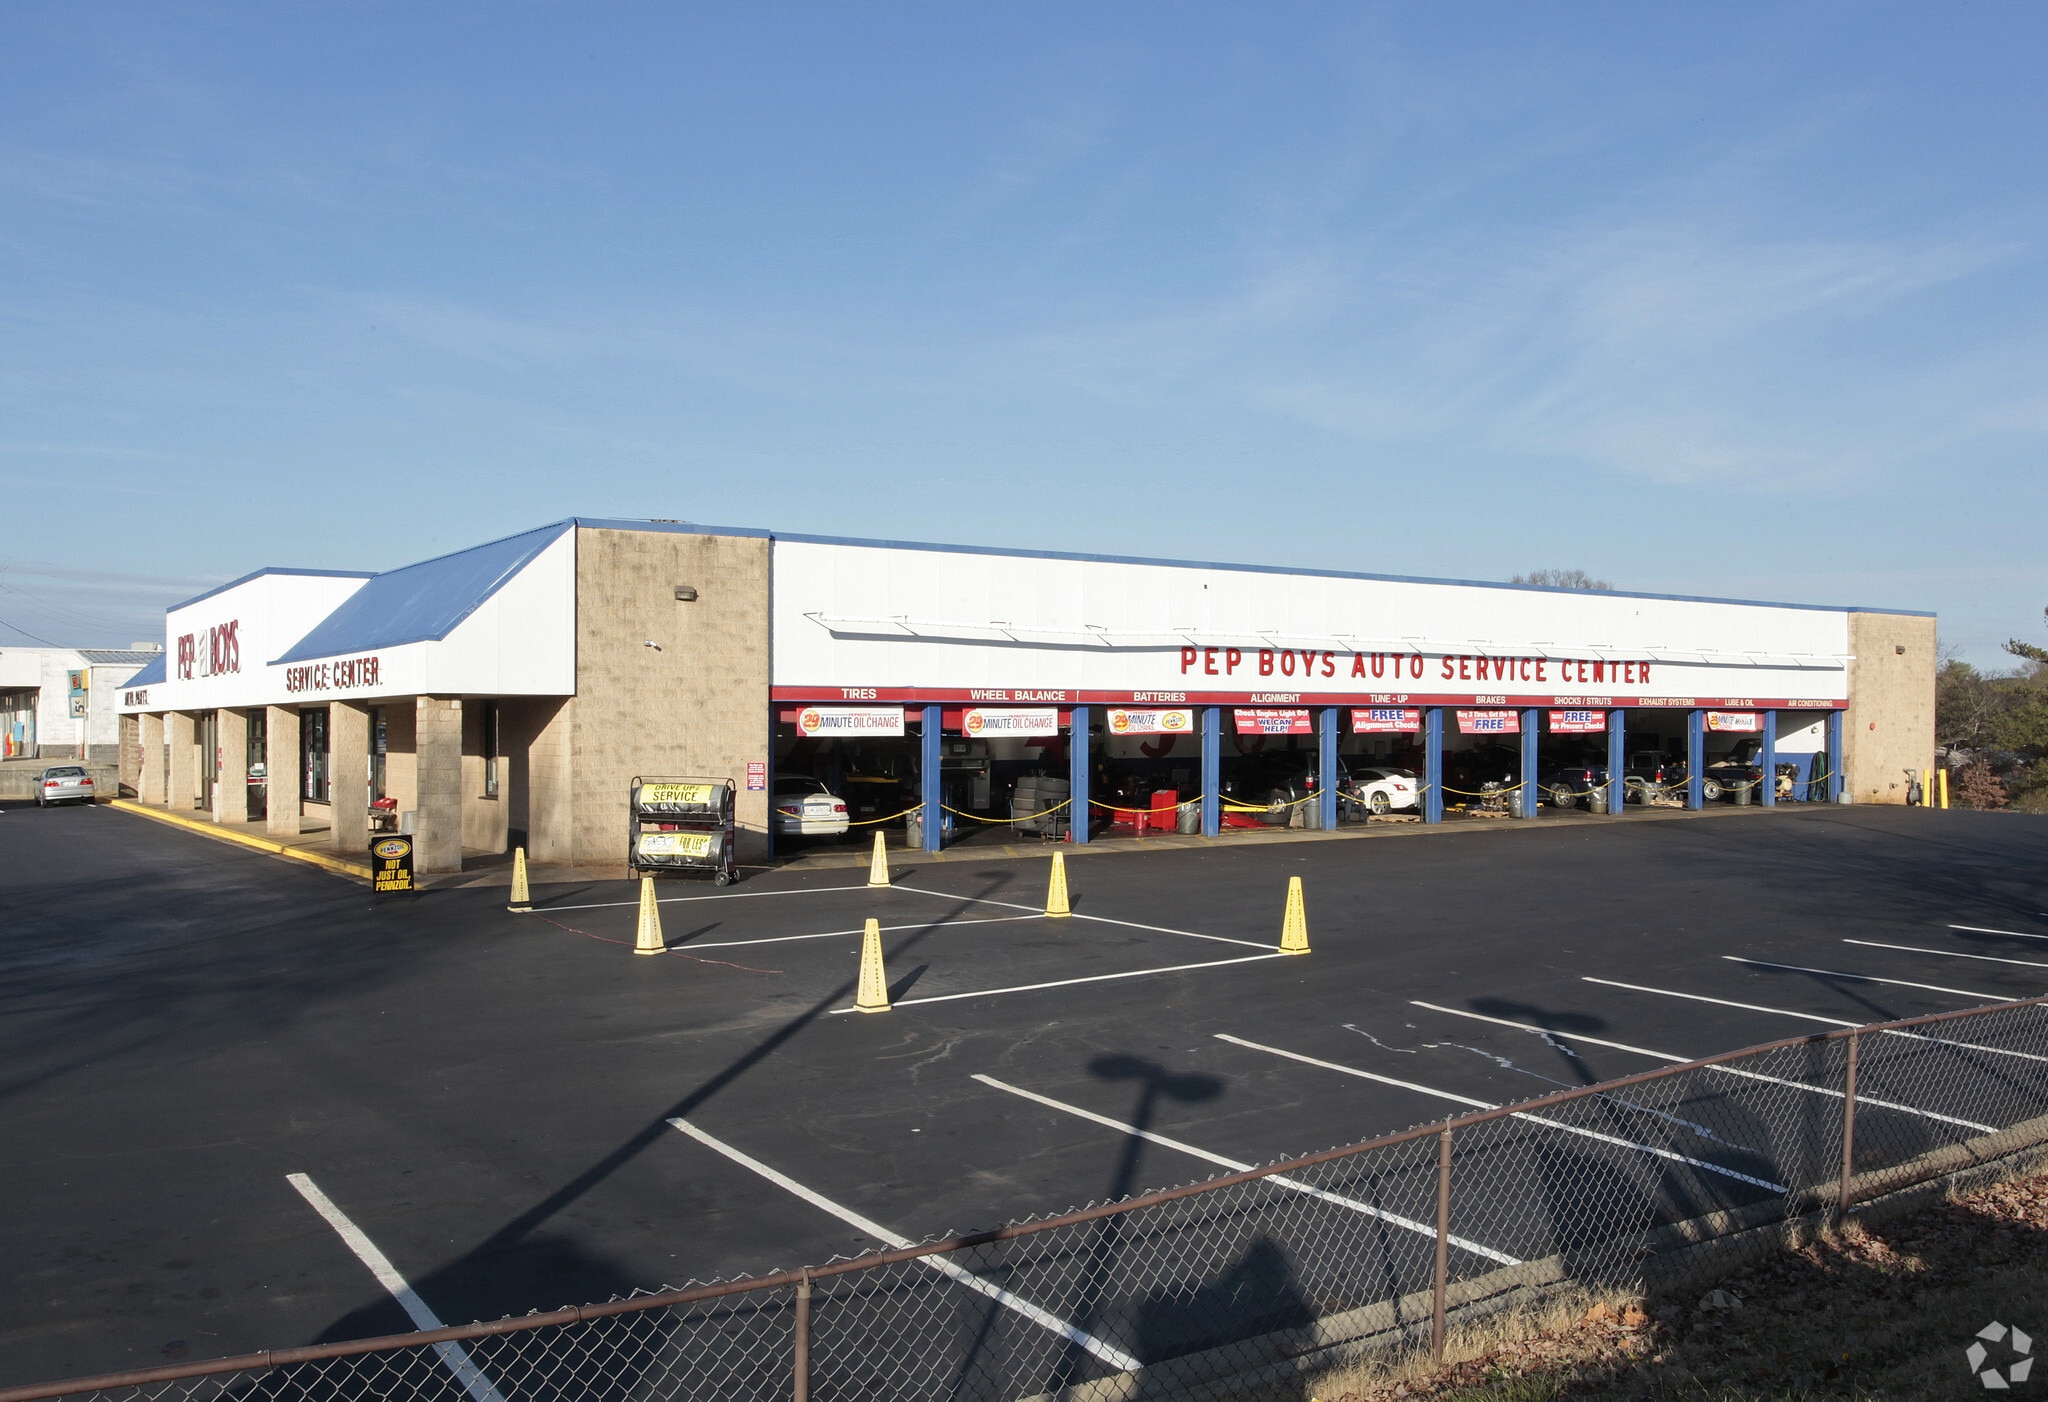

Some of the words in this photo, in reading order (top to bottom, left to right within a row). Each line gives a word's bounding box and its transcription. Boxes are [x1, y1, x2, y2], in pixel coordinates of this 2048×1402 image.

[178, 632, 195, 679] PEP
[210, 619, 239, 675] BOYS
[1181, 647, 1241, 675] PEP
[1259, 649, 1335, 677] BOYS
[1351, 652, 1424, 679] AUTO
[1441, 655, 1547, 682] SERVICE
[1562, 659, 1650, 684] CENTER
[287, 663, 327, 691] SERVICE
[334, 656, 379, 688] CENTER
[841, 688, 876, 699] TIRES
[971, 690, 1009, 700] WHEEL
[1014, 691, 1065, 701] BALANCE
[1134, 692, 1186, 702] BATTERIES
[1250, 693, 1301, 703] ALIGNMENT
[1370, 694, 1390, 703] TUNE
[1397, 694, 1408, 703] UP
[1475, 695, 1506, 704] BRAKES
[1554, 697, 1581, 705] SHOCKS
[1586, 697, 1612, 705] STRUTS
[1639, 698, 1667, 706] EXHAUST
[1668, 698, 1695, 706] SYSTEMS
[1371, 709, 1404, 720] FREE
[1565, 711, 1591, 721] FREE
[803, 714, 820, 727] 29
[820, 717, 852, 728] MINUTE
[853, 717, 865, 728] OIL
[867, 716, 899, 728] CHANGE
[967, 716, 983, 729] 29
[983, 718, 1011, 729] MINUTE
[1012, 718, 1023, 728] OIL
[1024, 718, 1053, 728] CHANGE
[1113, 715, 1128, 727] 29
[1128, 714, 1156, 725] MINUTE
[1355, 721, 1393, 730] Alignment
[1475, 719, 1503, 729] FREE
[653, 791, 699, 802] SERVICE
[385, 859, 400, 870] NOT
[376, 870, 396, 880] JUST
[376, 879, 412, 891] PENNZOIL.
